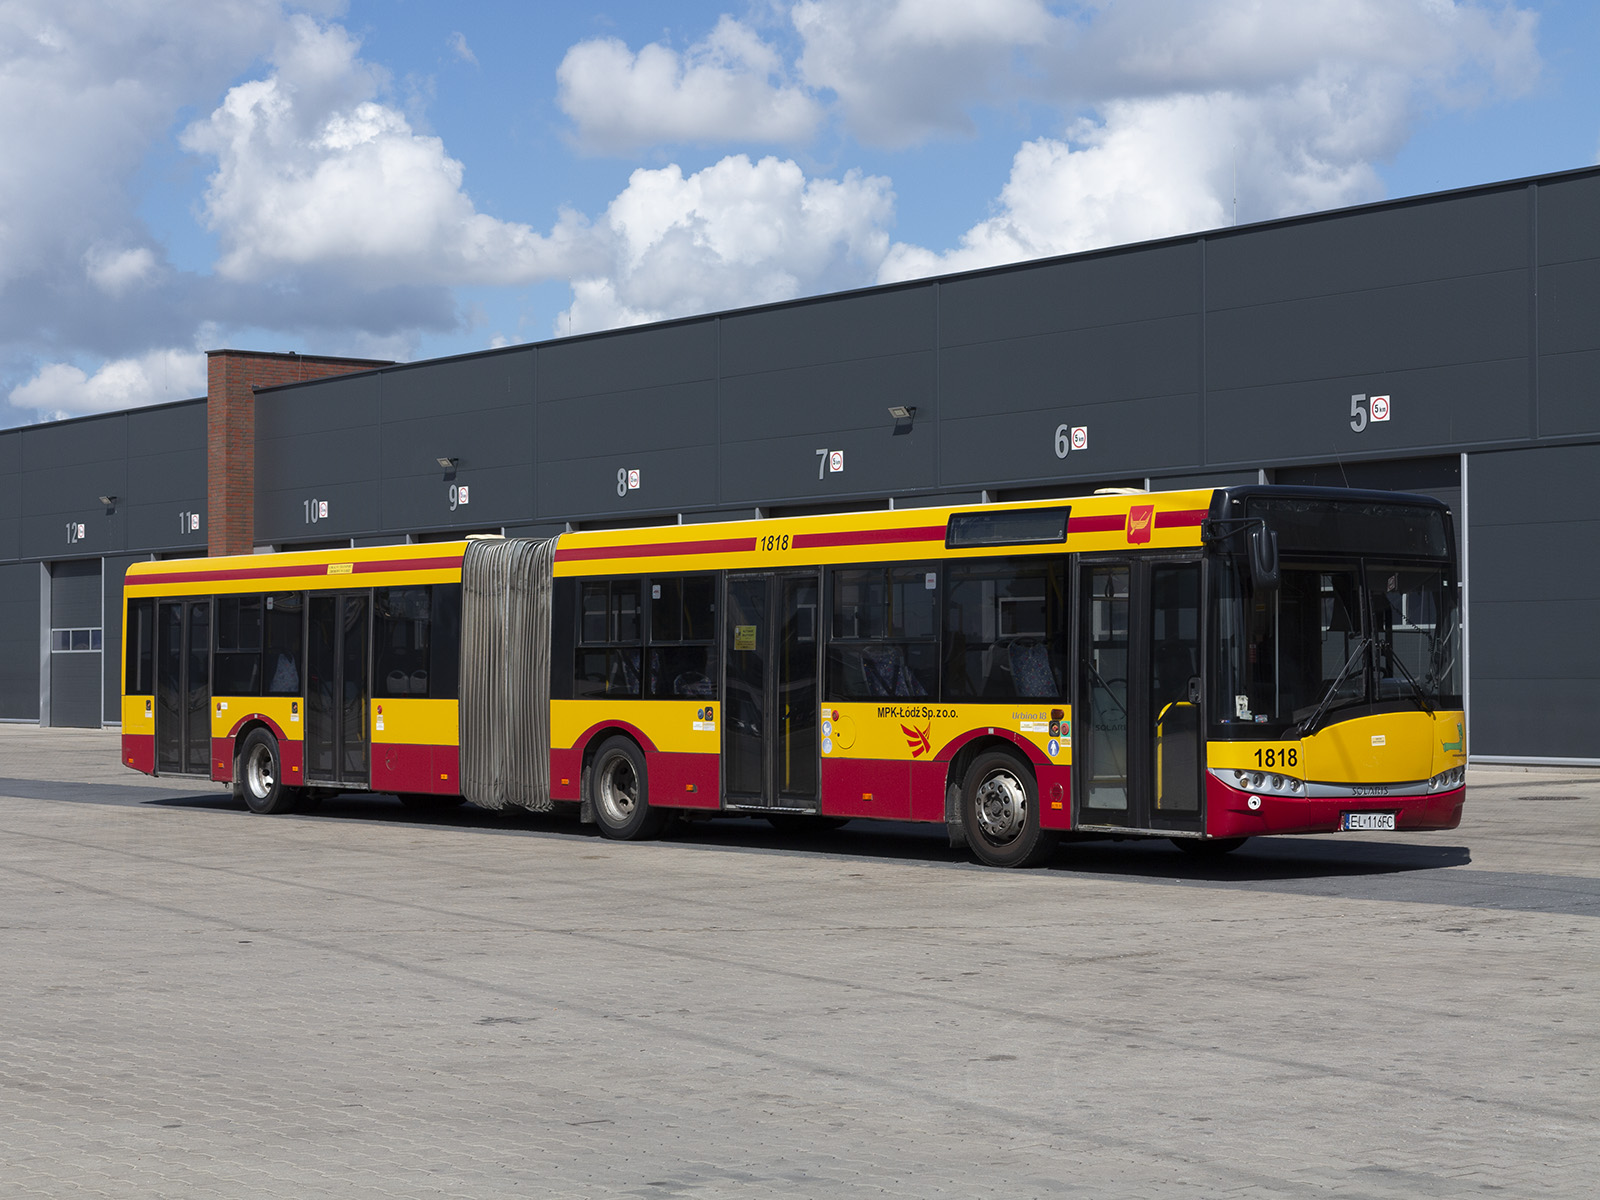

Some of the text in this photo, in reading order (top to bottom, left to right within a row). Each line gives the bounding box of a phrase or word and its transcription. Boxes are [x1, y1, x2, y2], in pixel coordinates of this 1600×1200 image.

[1350, 393, 1367, 432] 5
[1374, 404, 1379, 413] 5
[1055, 423, 1069, 459] 6
[815, 448, 828, 480] 7
[617, 467, 627, 497] 8
[449, 484, 457, 511] 9
[179, 510, 191, 534] 11
[303, 498, 318, 524] 10
[65, 521, 78, 544] 12
[760, 534, 789, 551] 1818
[877, 706, 920, 718] MPK-Łódź
[1012, 711, 1047, 720] Urbino 18
[1254, 748, 1298, 767] 1818
[1352, 786, 1389, 796] SOLARIS
